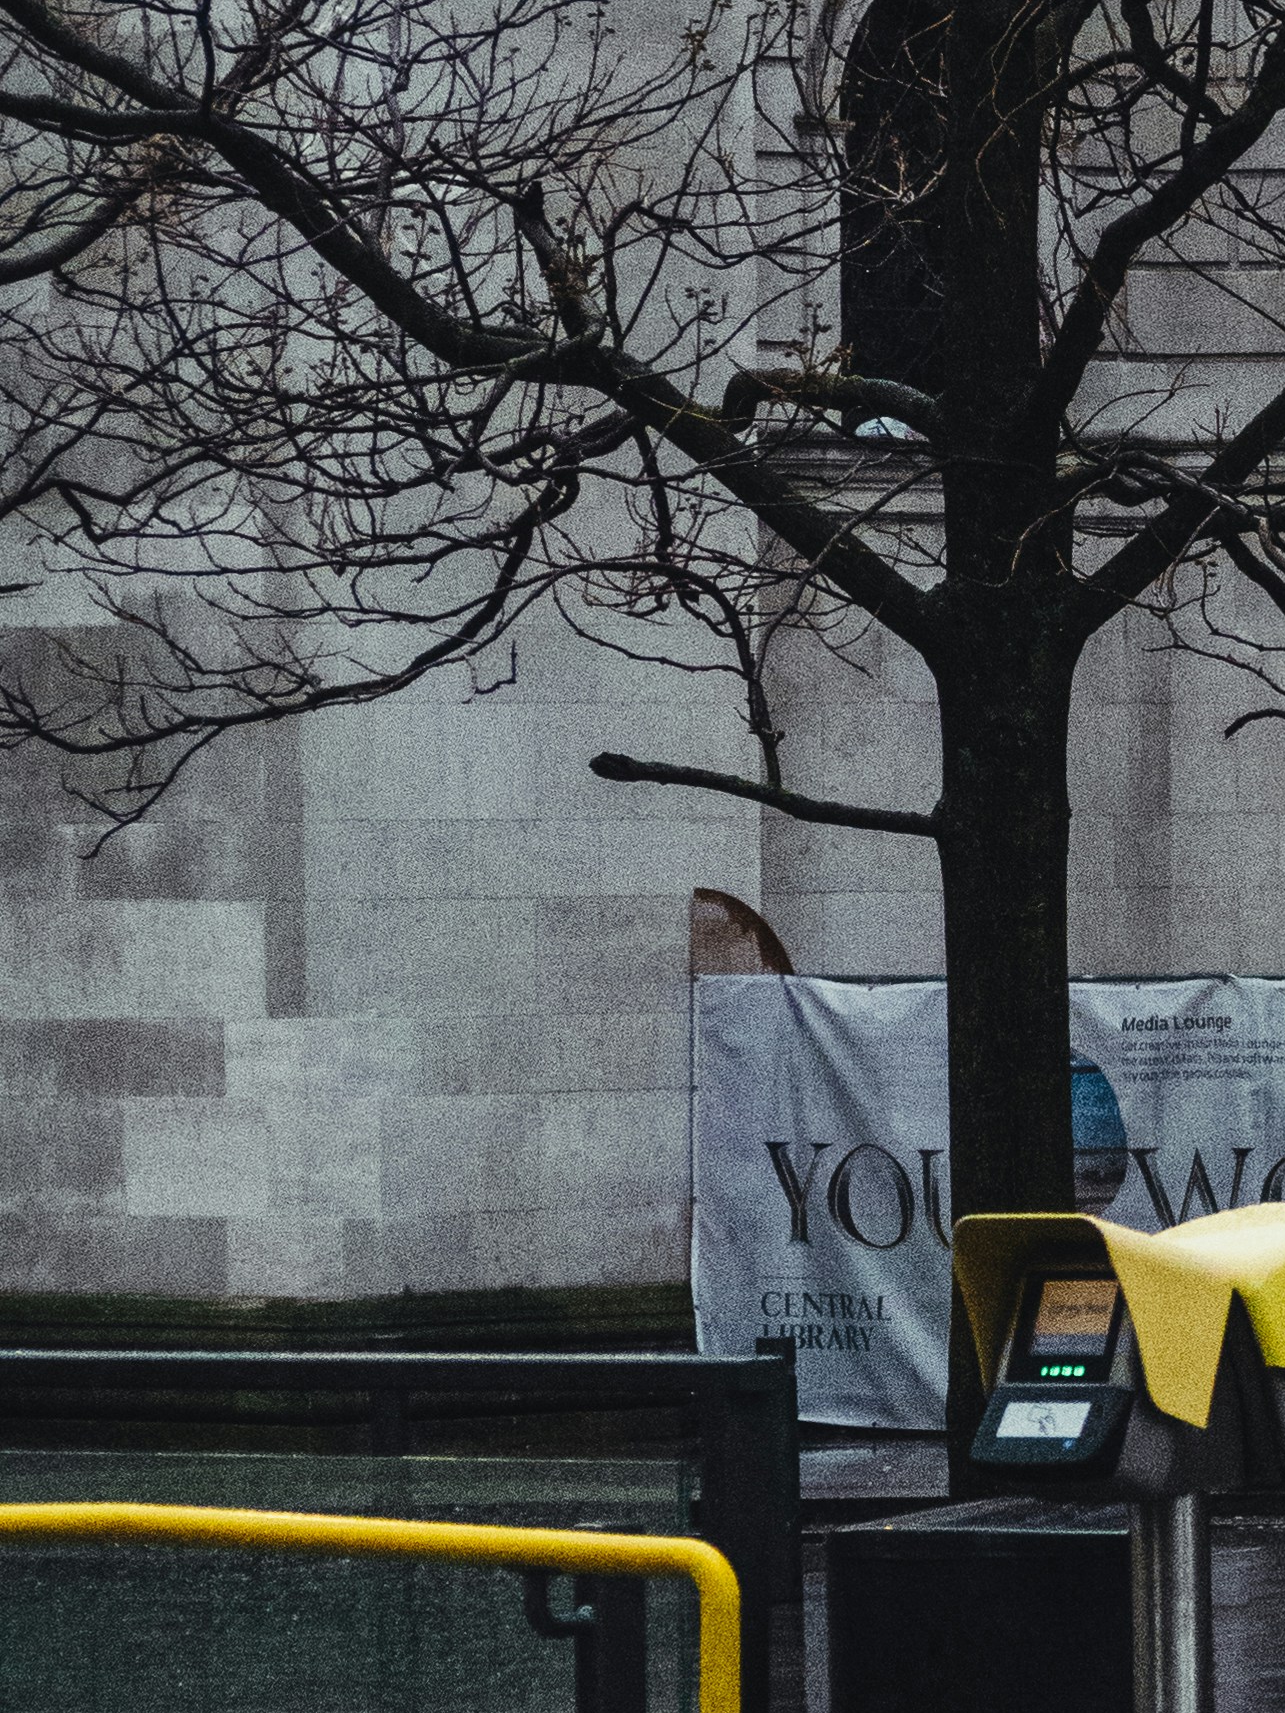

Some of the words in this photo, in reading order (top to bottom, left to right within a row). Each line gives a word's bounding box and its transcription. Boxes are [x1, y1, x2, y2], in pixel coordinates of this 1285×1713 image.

[1121, 1015, 1169, 1032] Media
[1173, 1015, 1232, 1033] Lounge
[764, 1142, 951, 1249] YOU
[761, 1291, 892, 1321] CENTRAL
